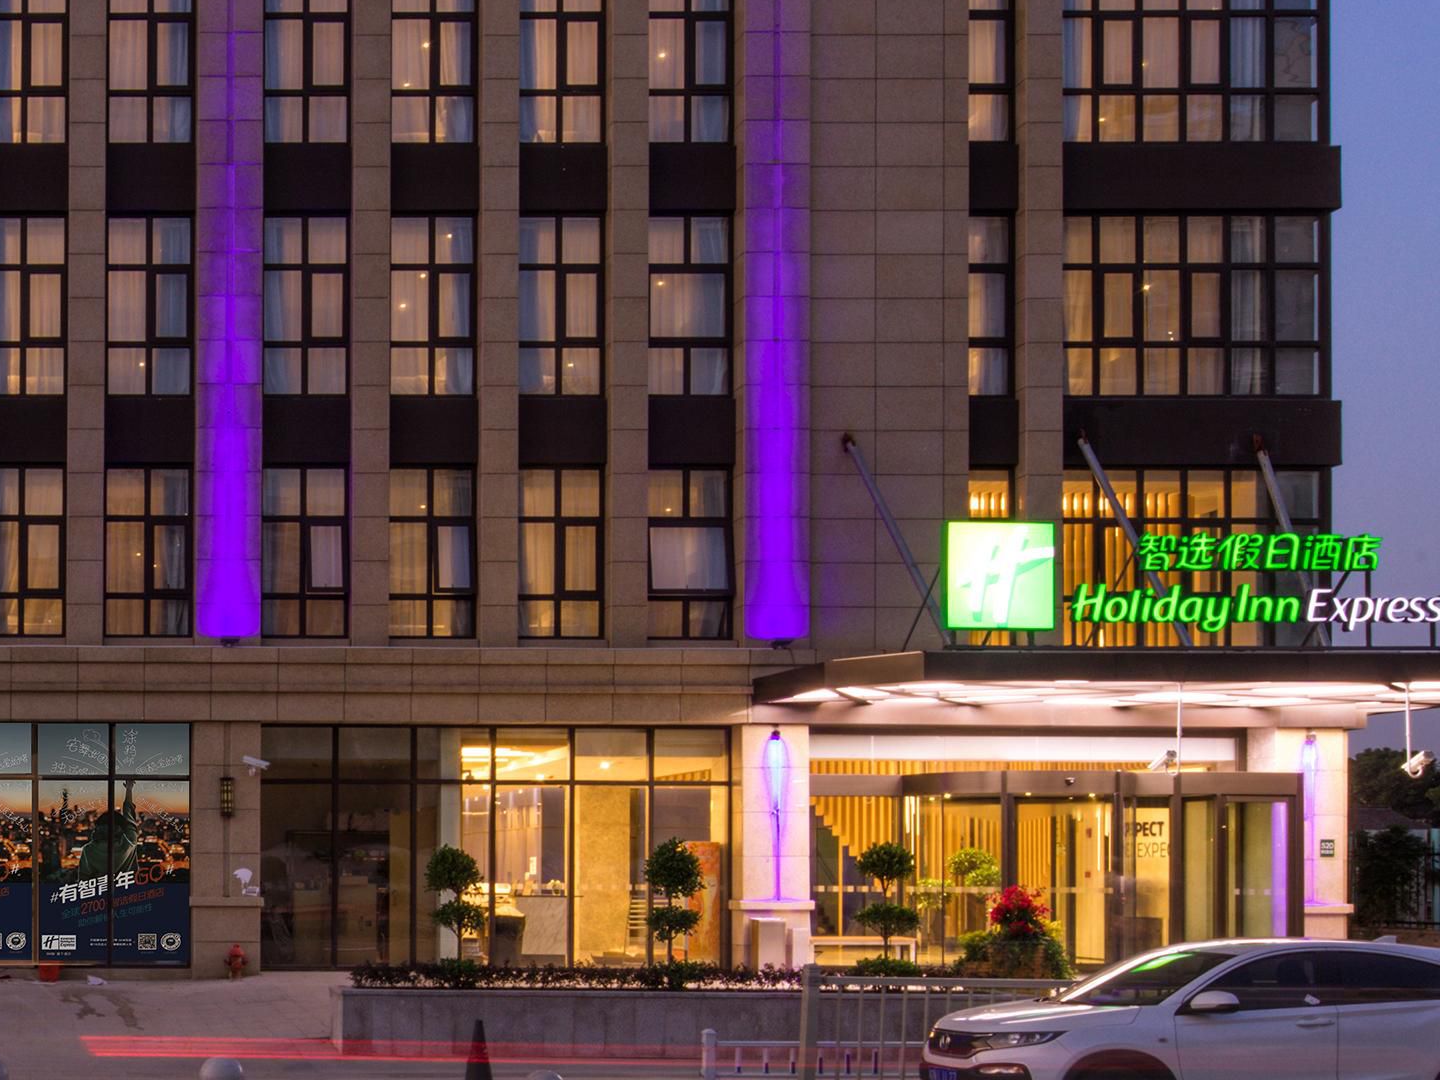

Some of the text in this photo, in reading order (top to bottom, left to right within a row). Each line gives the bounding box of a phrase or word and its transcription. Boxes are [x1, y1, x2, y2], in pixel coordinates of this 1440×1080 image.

[1139, 531, 1384, 571] 智选假日酒店
[1072, 583, 1440, 633] Holiday Inn Express
